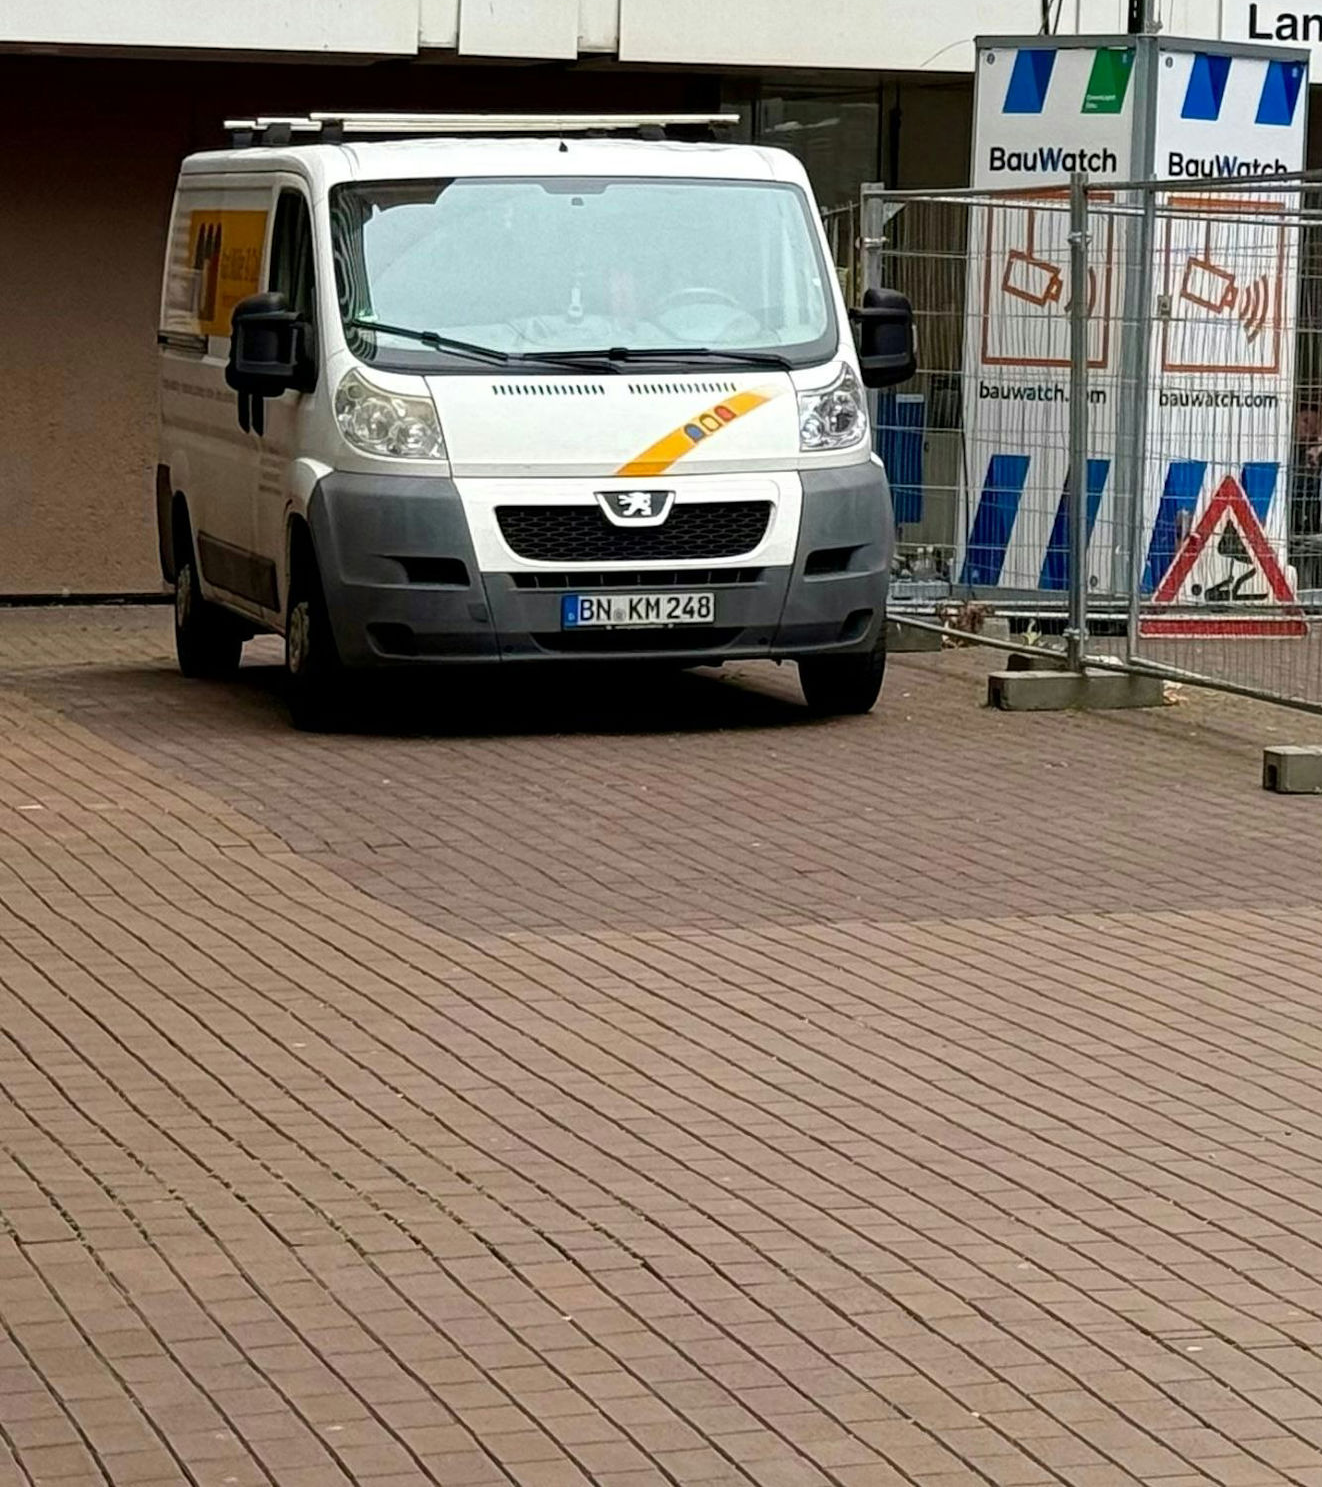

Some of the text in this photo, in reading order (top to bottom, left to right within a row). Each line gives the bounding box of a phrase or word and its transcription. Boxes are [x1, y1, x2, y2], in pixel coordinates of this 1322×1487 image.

[988, 146, 1117, 173] BauWatch
[1168, 151, 1288, 178] BauWatch
[978, 380, 1107, 404] bauwatch.m
[1158, 387, 1279, 409] bauwatch.com
[579, 598, 612, 622] BN
[628, 597, 661, 621] KM
[666, 595, 711, 620] 248
